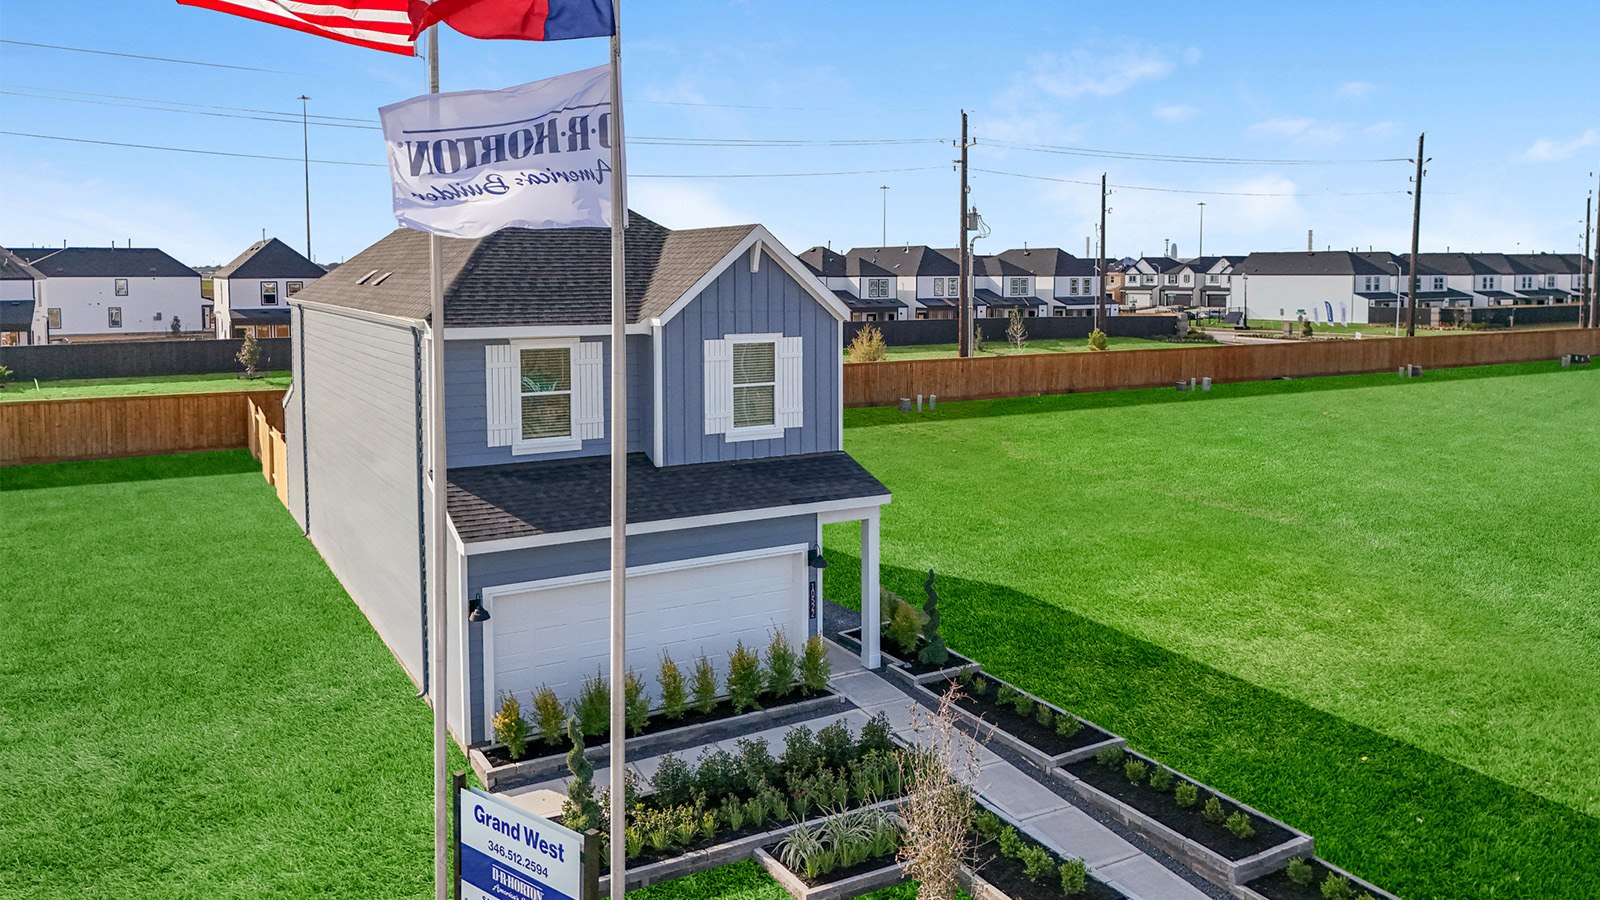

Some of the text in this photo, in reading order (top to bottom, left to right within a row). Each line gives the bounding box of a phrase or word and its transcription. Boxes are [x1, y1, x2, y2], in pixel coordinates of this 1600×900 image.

[474, 804, 565, 863] Grand West
[487, 840, 549, 879] 346.512.2594
